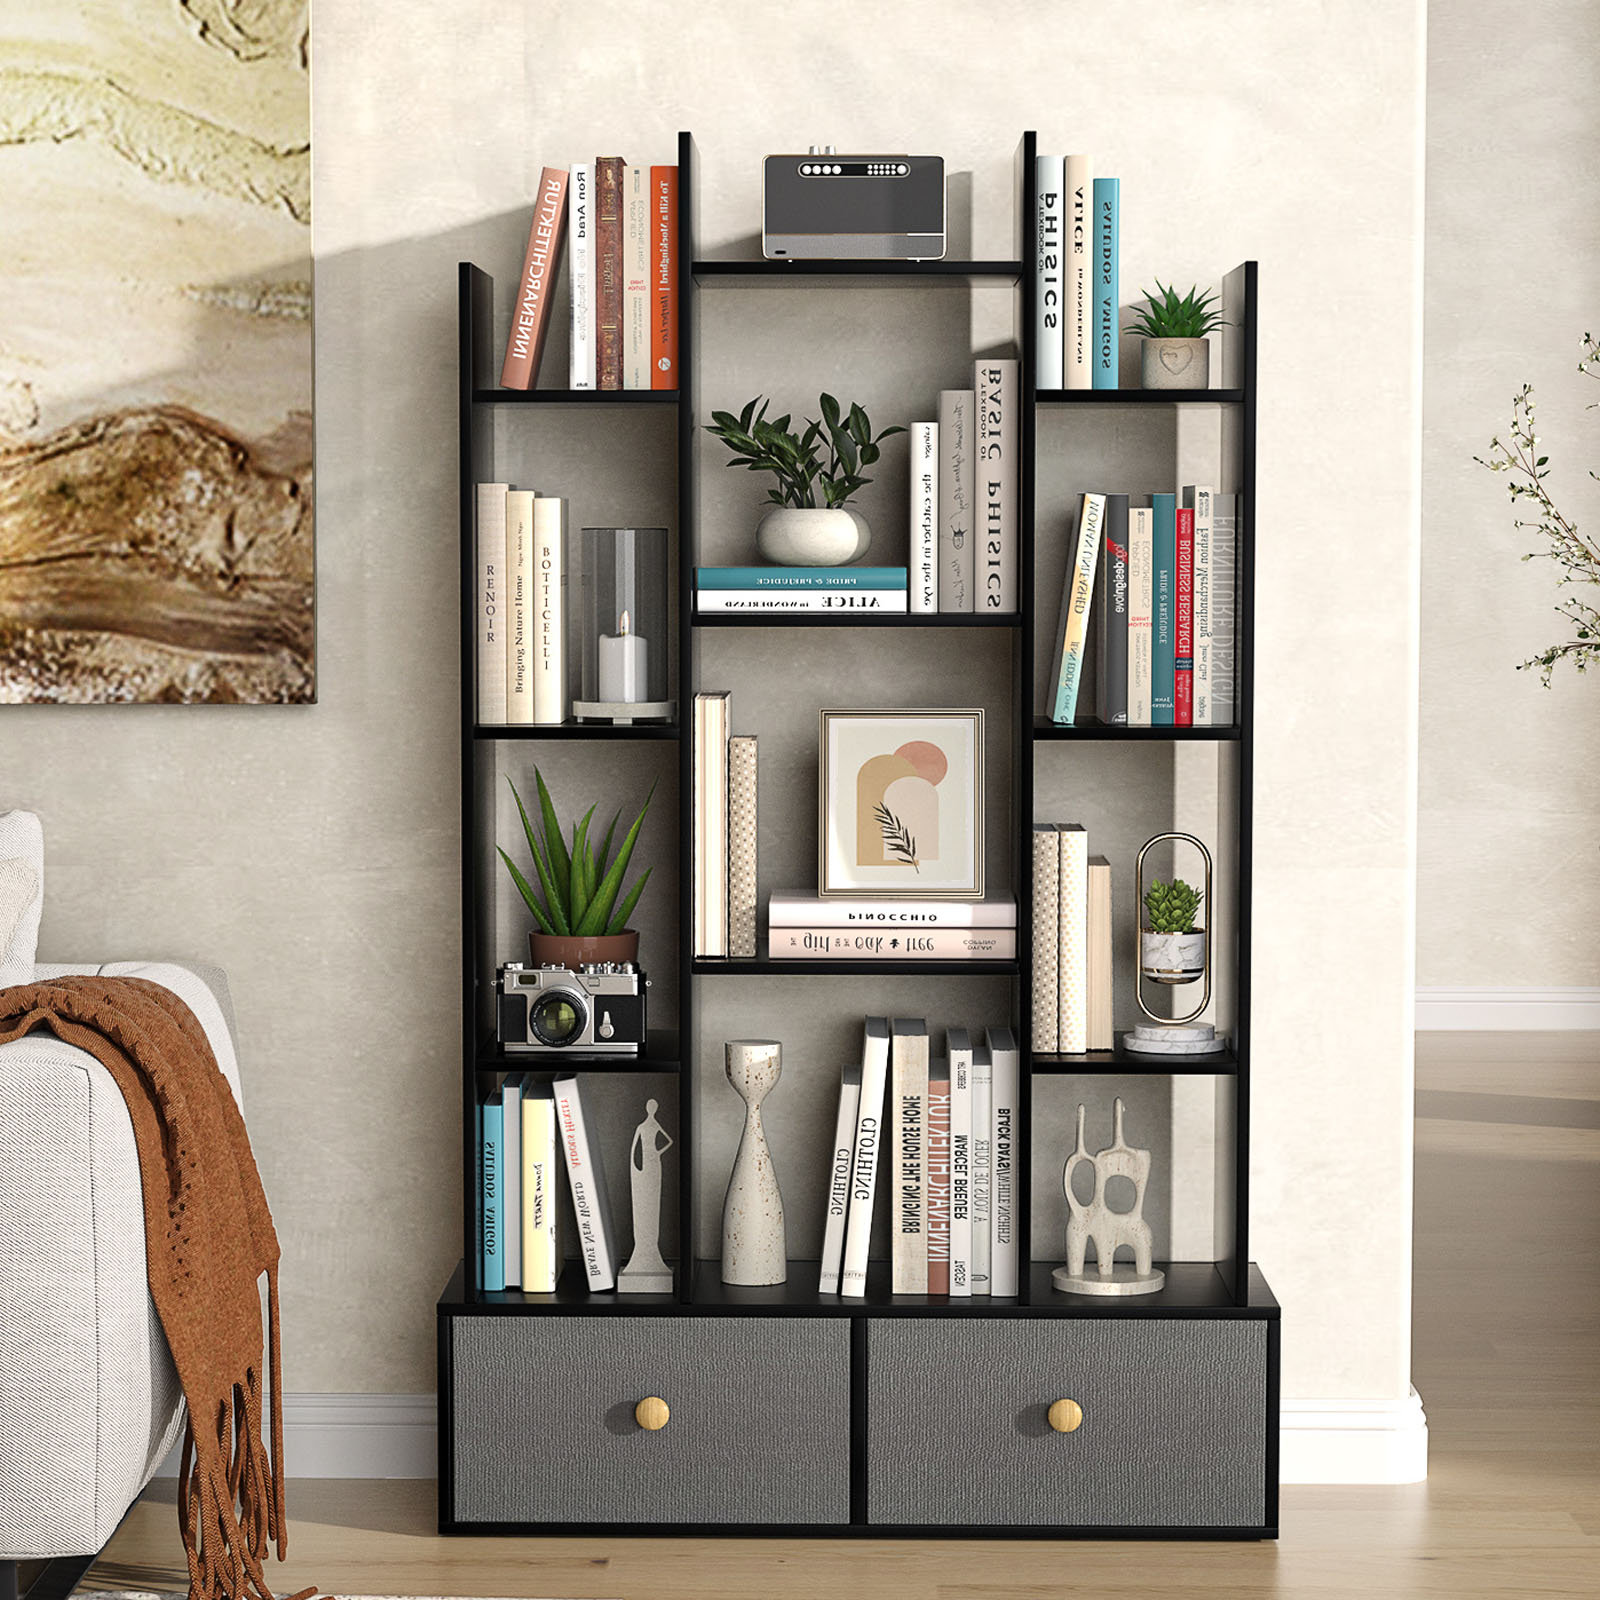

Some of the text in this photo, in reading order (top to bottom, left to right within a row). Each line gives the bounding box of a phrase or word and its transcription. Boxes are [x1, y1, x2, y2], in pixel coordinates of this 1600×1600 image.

[486, 565, 496, 642] RENOIR
[515, 575, 523, 607] Home
[542, 547, 551, 671] BOTTICELLI
[515, 610, 523, 645] Nature
[515, 648, 525, 694] Bringing
